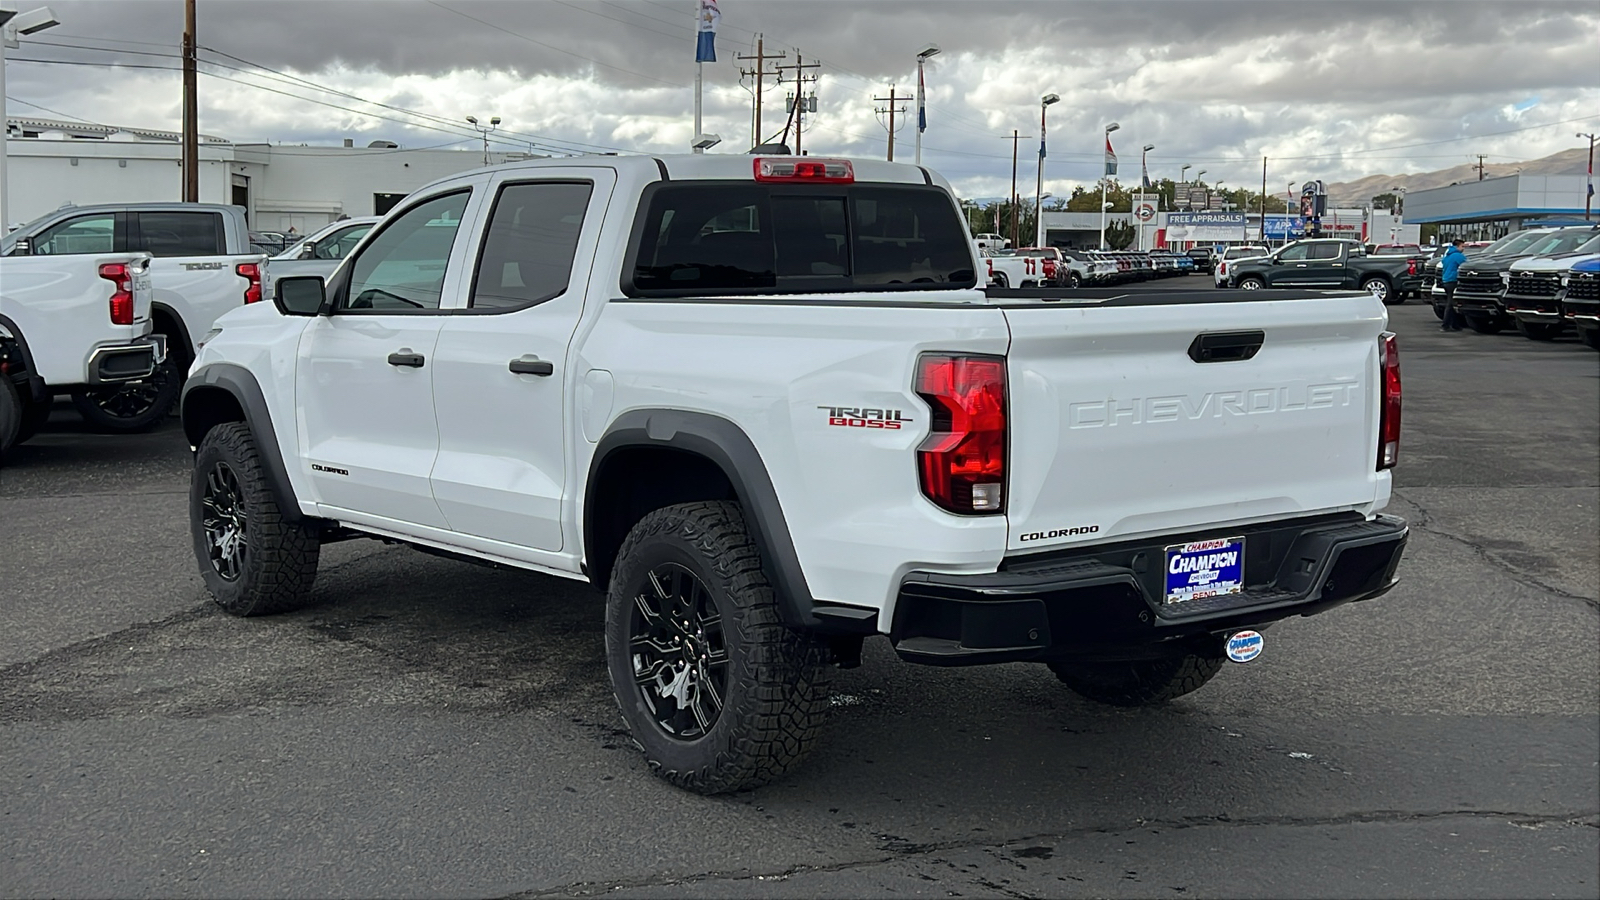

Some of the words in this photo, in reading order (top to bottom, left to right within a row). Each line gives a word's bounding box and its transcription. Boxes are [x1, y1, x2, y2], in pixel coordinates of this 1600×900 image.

[1169, 215, 1190, 223] FREE
[1191, 214, 1243, 223] APPRAISALS!
[1069, 381, 1358, 429] CHEVROLET
[817, 406, 913, 421] TRAIL
[829, 418, 901, 429] BOSS
[1020, 525, 1099, 542] COLORADO
[1187, 541, 1224, 552] CHAMPION
[1169, 551, 1237, 574] CHAMPION
